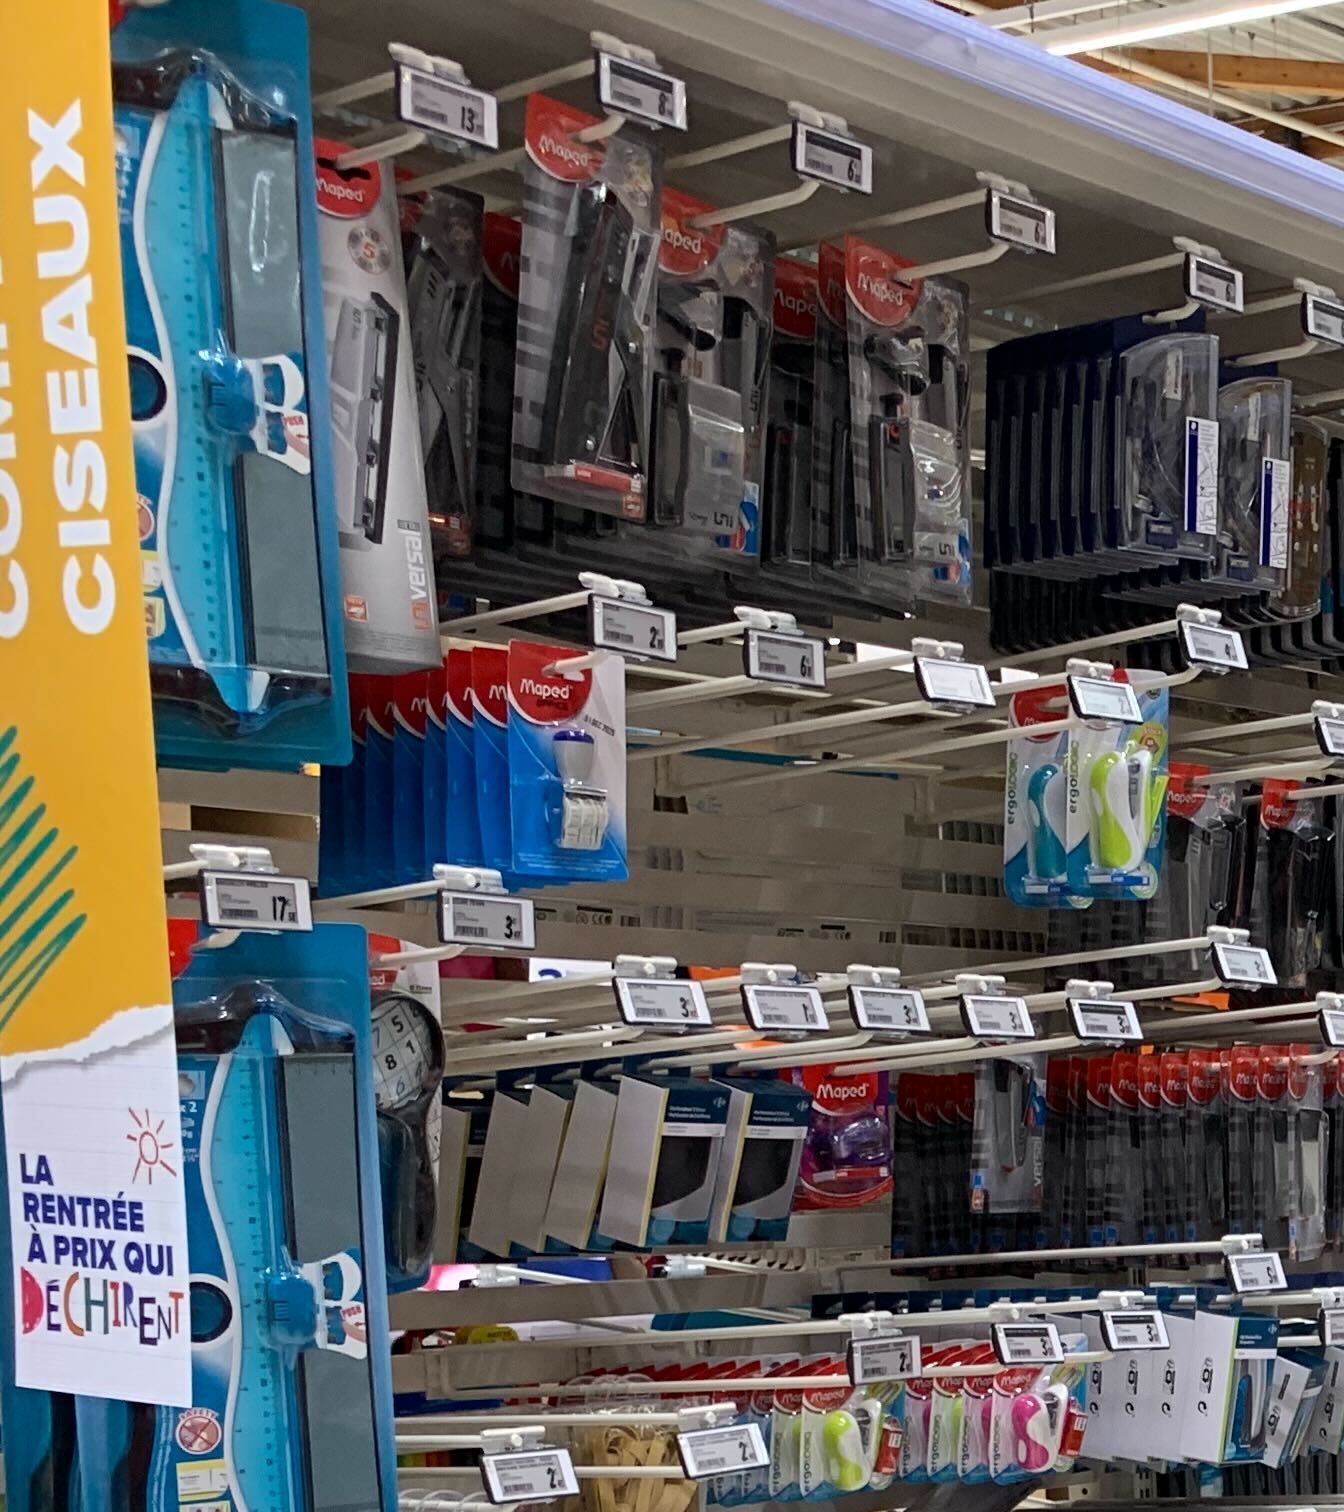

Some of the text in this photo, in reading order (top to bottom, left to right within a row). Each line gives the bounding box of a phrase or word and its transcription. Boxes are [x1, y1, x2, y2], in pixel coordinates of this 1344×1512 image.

[539, 134, 591, 166] Maped
[662, 227, 702, 255] aped
[857, 273, 904, 306] Maped
[27, 97, 116, 635] CISEAUX
[519, 677, 570, 702] Maped
[816, 1082, 870, 1100] Maped
[20, 1152, 54, 1187] LA
[23, 1191, 145, 1233] RENTRÉE
[28, 1223, 173, 1277] À PRIX QUI
[20, 1265, 184, 1346] DÉCHIRENT
